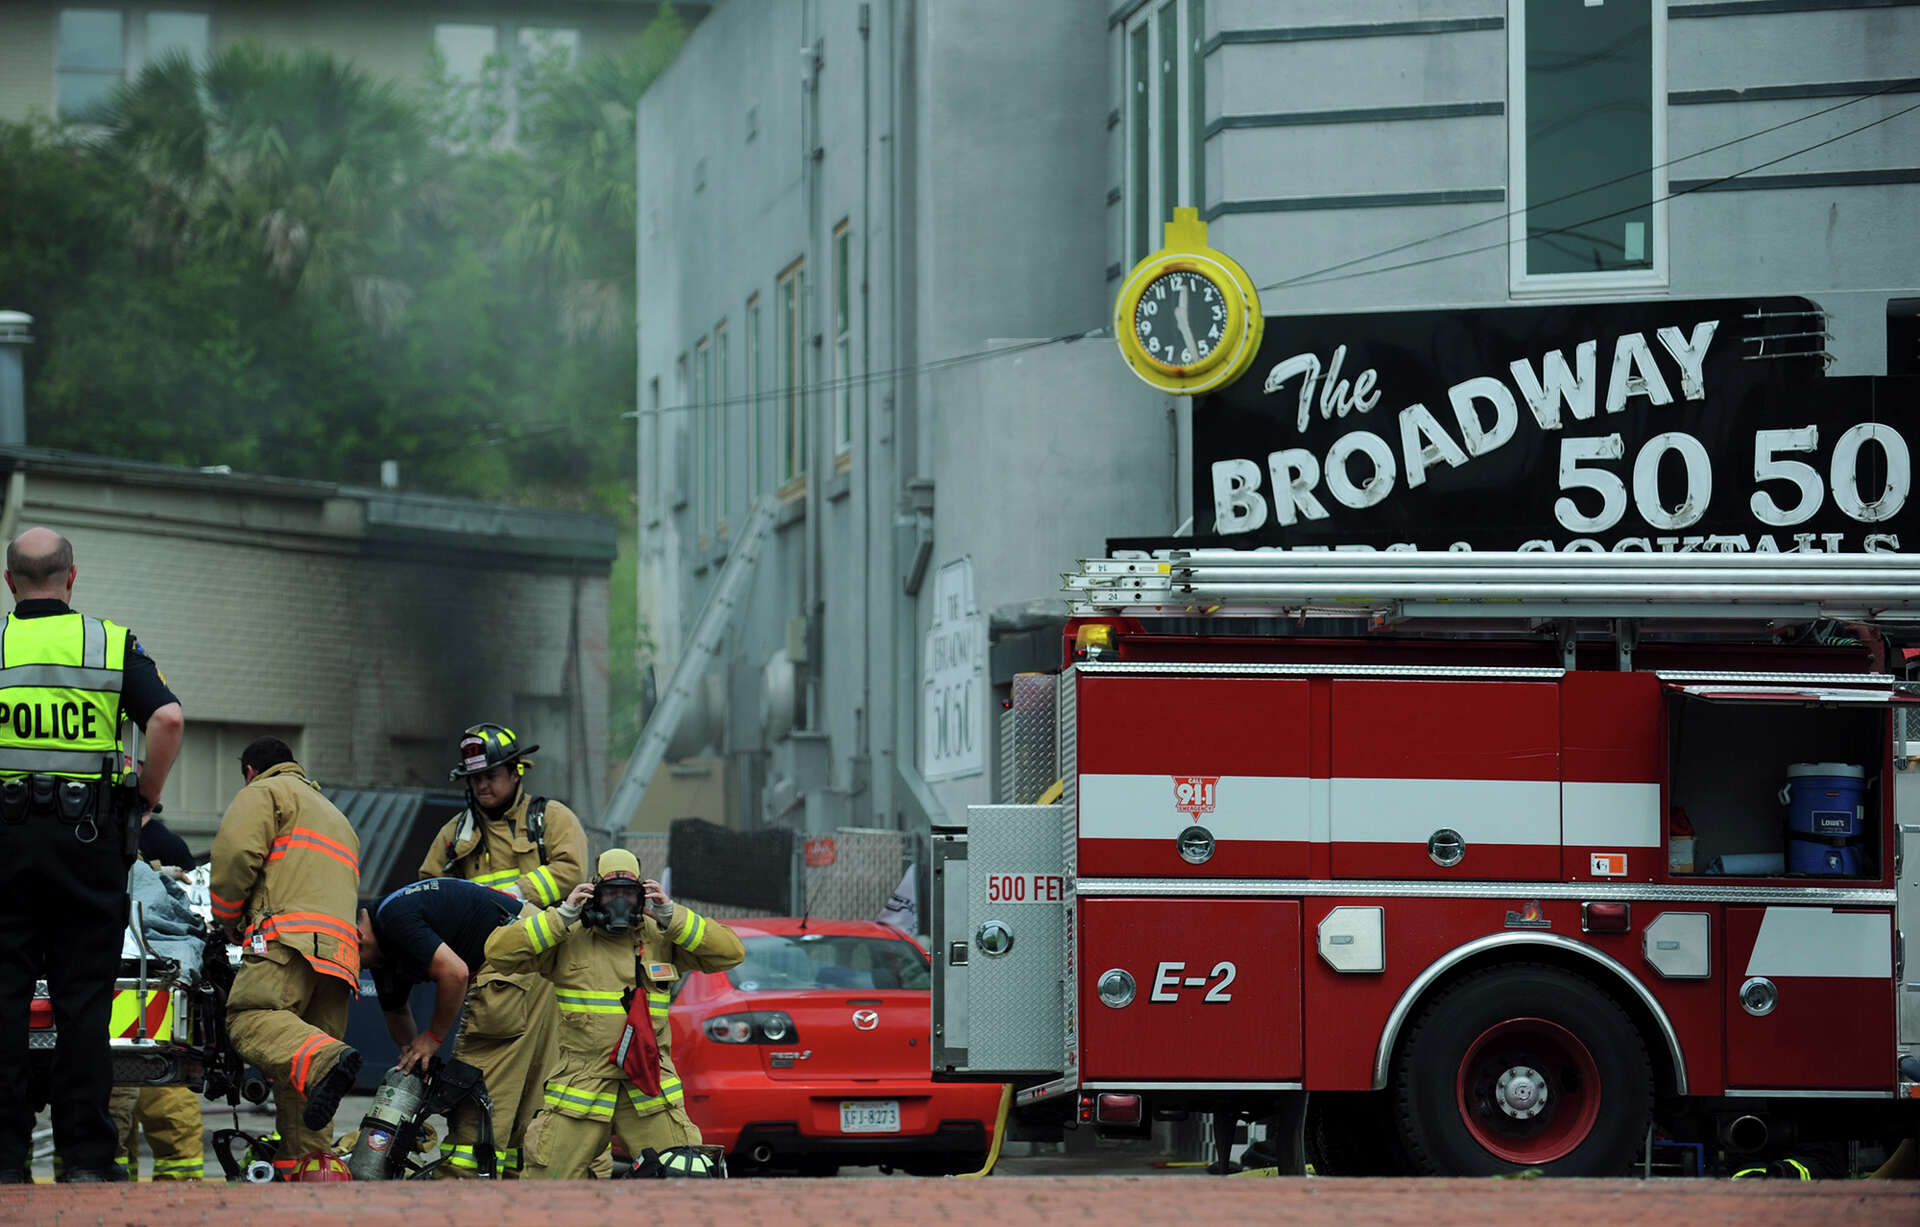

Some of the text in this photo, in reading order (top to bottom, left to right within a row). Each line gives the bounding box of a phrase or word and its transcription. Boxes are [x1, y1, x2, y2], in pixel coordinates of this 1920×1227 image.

[1170, 277, 1183, 290] 12
[1190, 279, 1196, 292] 1
[1154, 286, 1166, 300] 11
[1204, 287, 1213, 302] 2
[1143, 301, 1158, 316] 10
[1211, 305, 1222, 321] 3
[1140, 320, 1152, 336] 9
[1208, 322, 1219, 338] 4
[1148, 336, 1161, 352] 8
[1198, 340, 1209, 355] 5
[1164, 346, 1174, 361] 7
[1181, 348, 1192, 362] 6
[1264, 345, 1382, 433] The
[1212, 320, 1719, 535] BROADWAY
[1554, 423, 1911, 533] 50 50
[1108, 593, 1118, 601] 24
[0, 701, 96, 740] POLICE
[989, 876, 1025, 901] 500
[1148, 961, 1237, 1004] E-2
